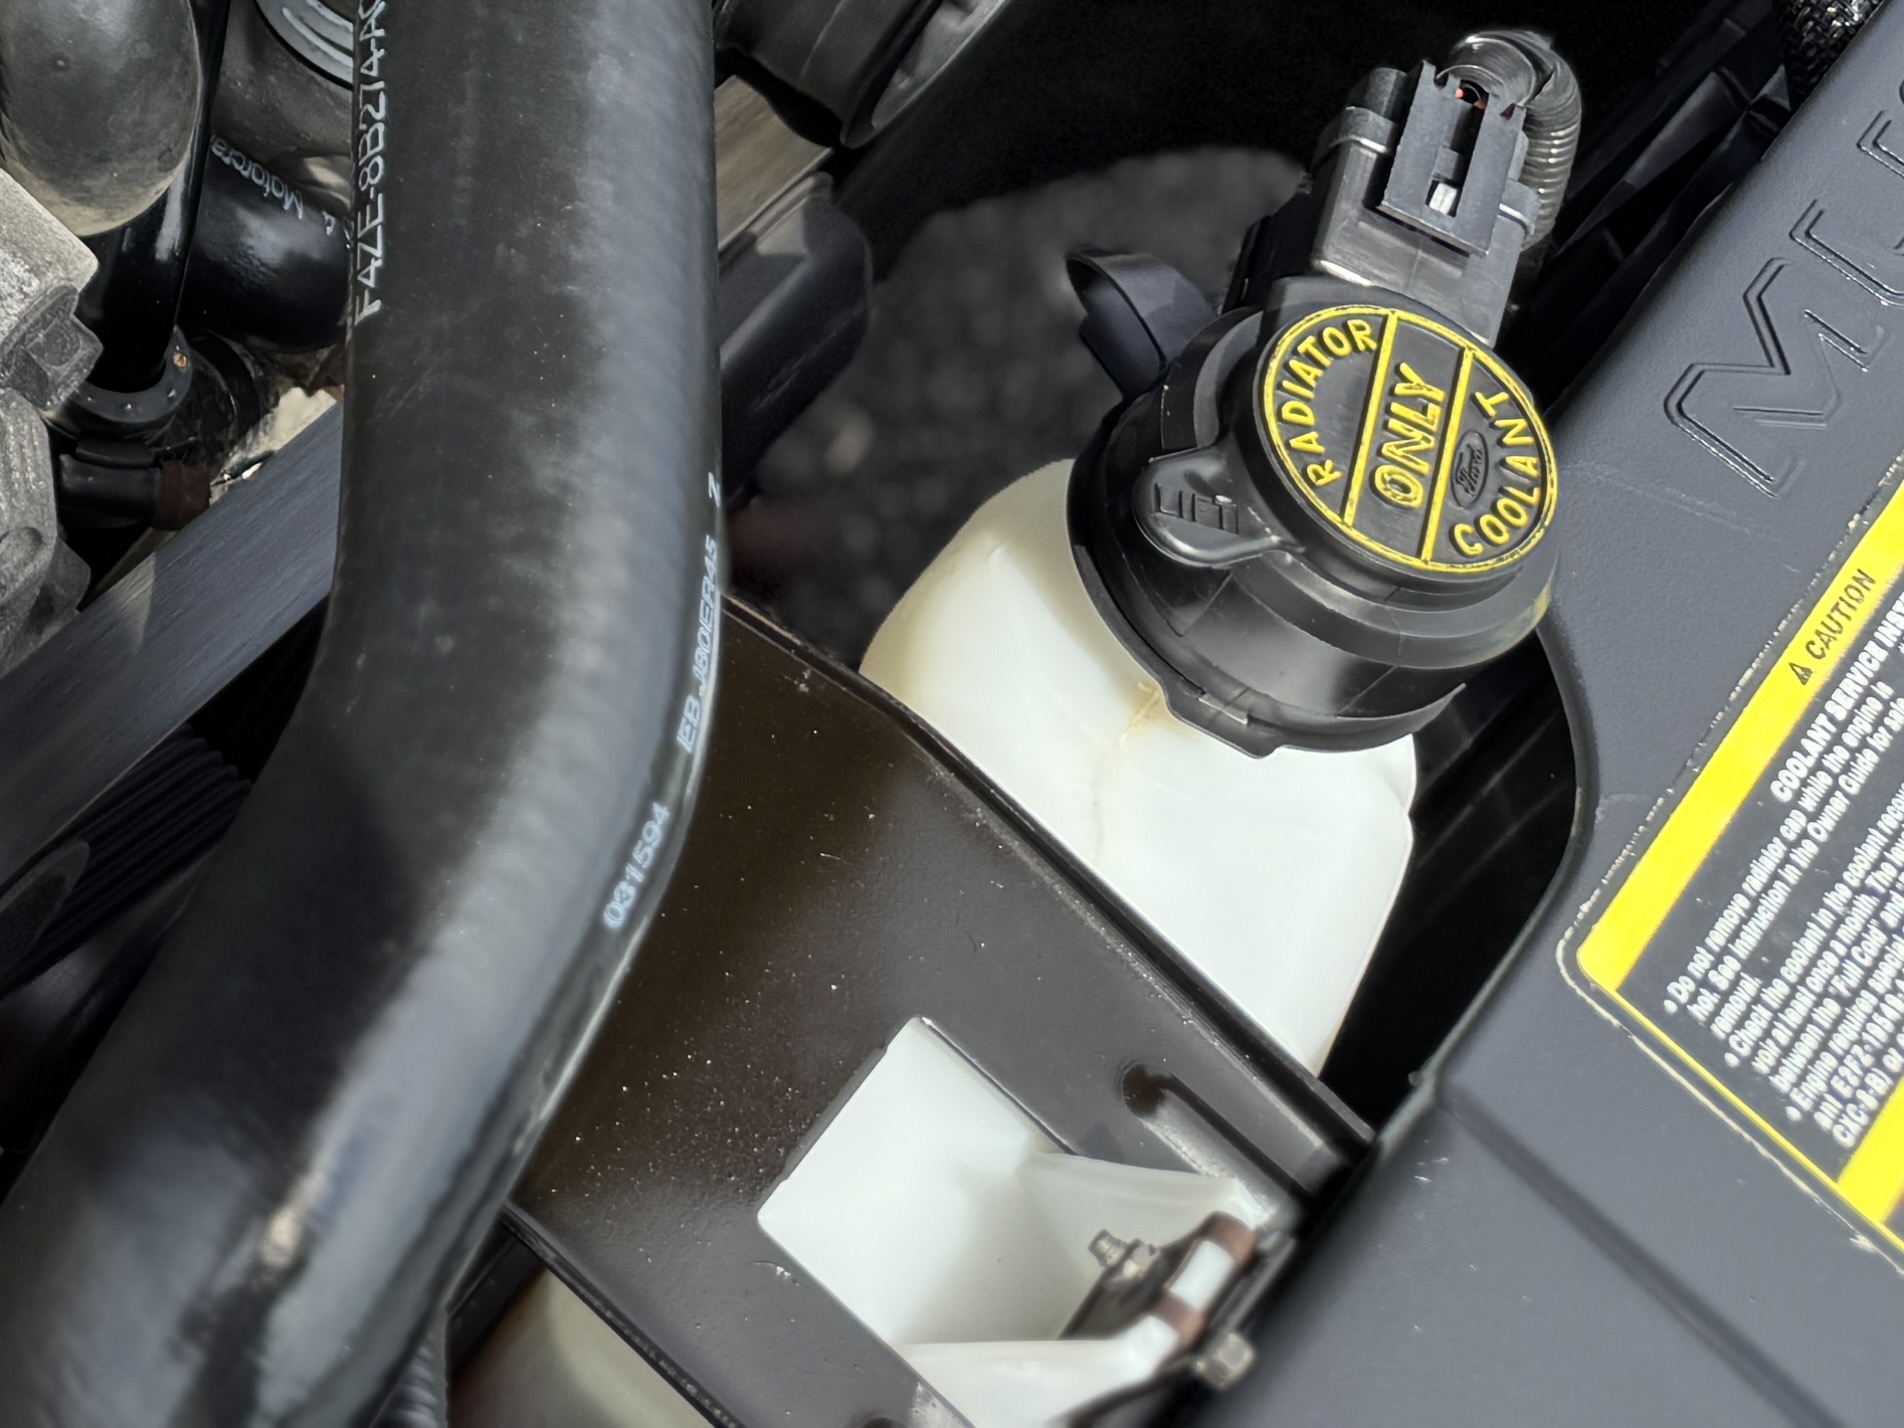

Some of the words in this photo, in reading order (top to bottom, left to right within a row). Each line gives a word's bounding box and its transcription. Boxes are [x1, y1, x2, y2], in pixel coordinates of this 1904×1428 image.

[1280, 318, 1377, 487] RADIATOR
[1373, 361, 1445, 509] ONLY
[1452, 390, 1542, 558] COOLANT
[1154, 480, 1241, 535] LIFT
[1801, 566, 1878, 663] CAUTION
[1766, 710, 1841, 804] COOLANT
[1822, 638, 1890, 722] SERVICE
[1699, 889, 1756, 955] remove
[1735, 832, 1791, 898] radiator
[1835, 691, 1888, 752] engine
[1725, 875, 1794, 961] instruction
[1803, 786, 1853, 843] Owner
[1834, 743, 1882, 796] Guide
[1724, 999, 1776, 1058] Check
[1773, 918, 1830, 985] coolant
[1836, 825, 1890, 888] coolant
[1829, 886, 1882, 947] month.
[1703, 968, 1763, 1041] removal.
[1765, 1019, 1828, 1095] between
[1785, 1047, 1844, 1114] Engine
[1821, 985, 1884, 1059] requires
